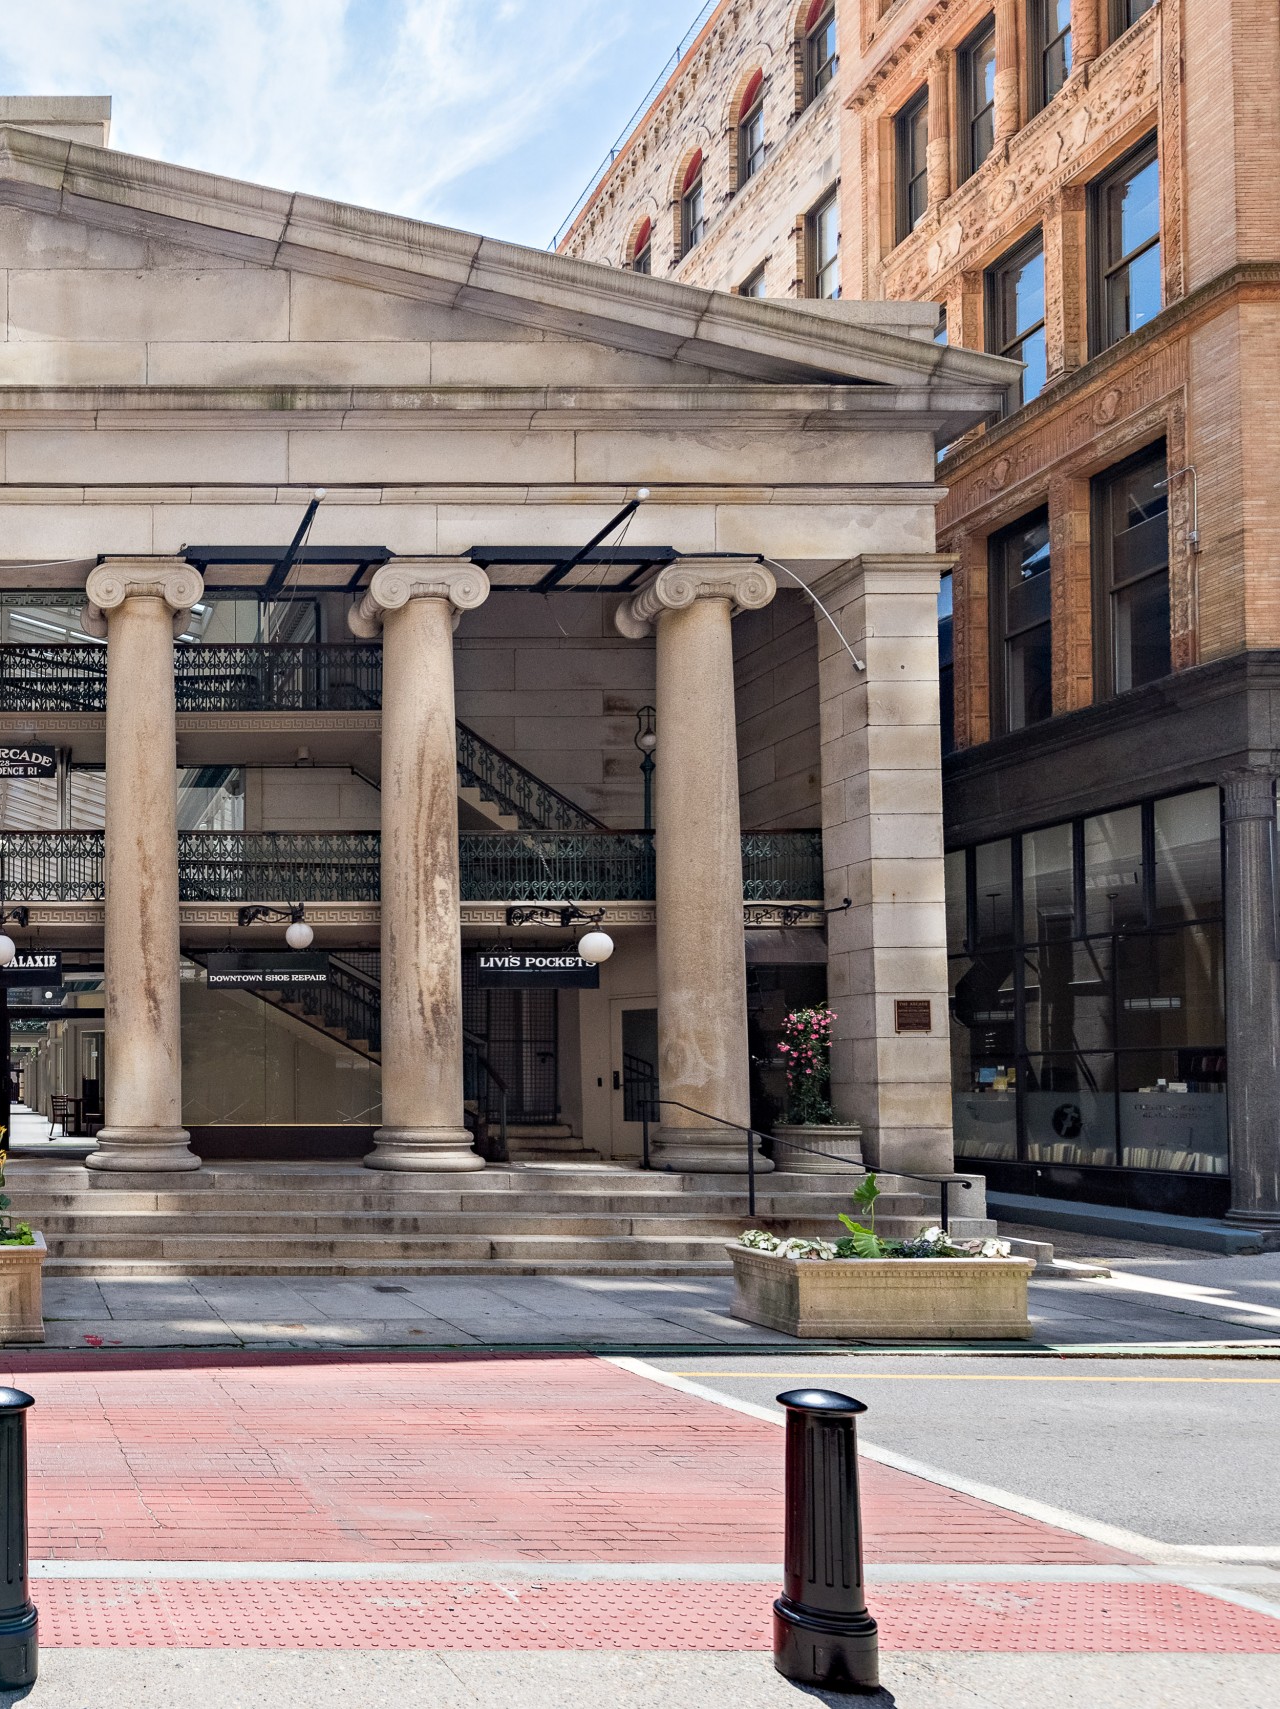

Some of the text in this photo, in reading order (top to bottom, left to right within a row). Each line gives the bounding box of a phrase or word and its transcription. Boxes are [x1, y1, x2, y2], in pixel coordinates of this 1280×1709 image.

[27, 766, 38, 775] RI
[479, 955, 521, 968] LIVI'S
[265, 974, 290, 982] SHOE
